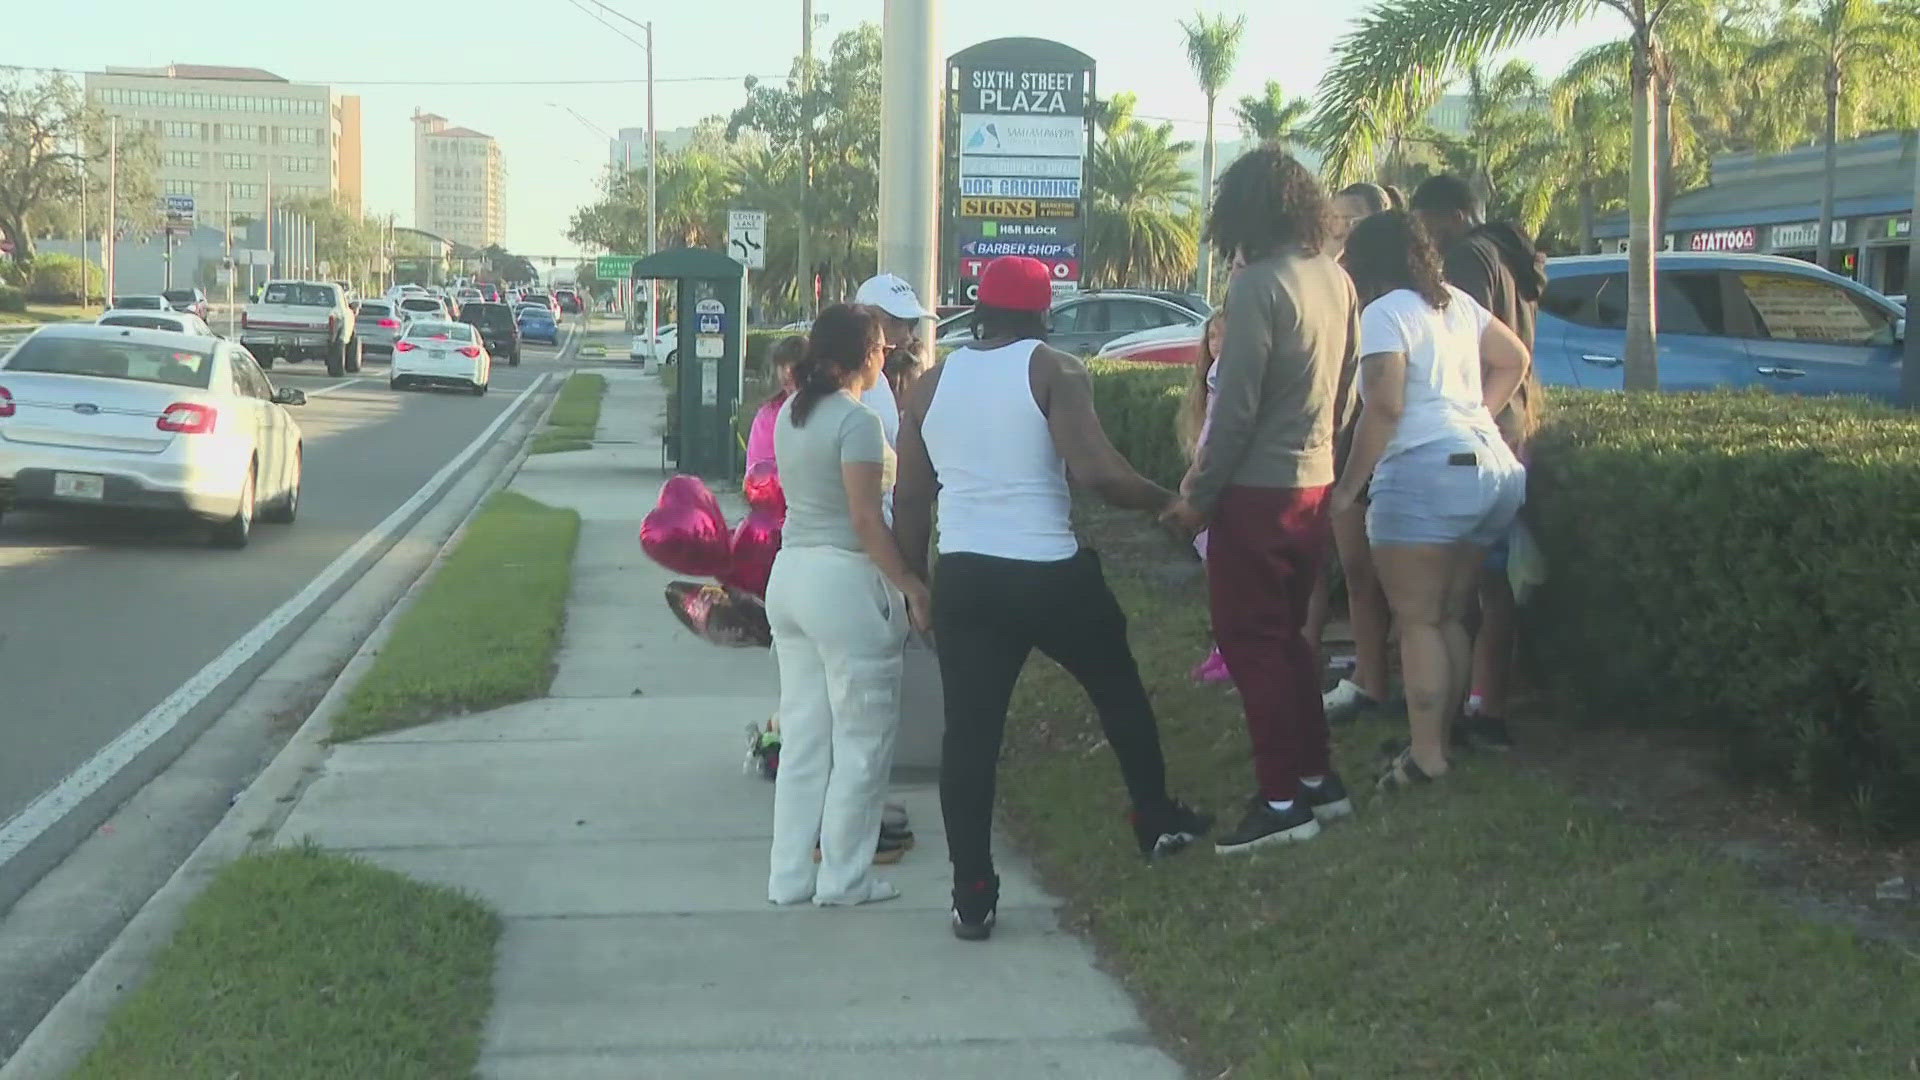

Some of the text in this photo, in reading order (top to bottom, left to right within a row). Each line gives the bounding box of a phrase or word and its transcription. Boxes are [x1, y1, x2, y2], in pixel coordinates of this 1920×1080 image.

[973, 70, 1074, 91] SIXTH STREET
[980, 89, 1066, 113] PLAZA
[963, 179, 1078, 197] DOG GROOMING
[965, 199, 1032, 216] SIGNS
[1000, 225, 1057, 235] H&R BLOCK
[1701, 229, 1744, 250] TATTOO
[978, 243, 1061, 256] BARBER SHOP
